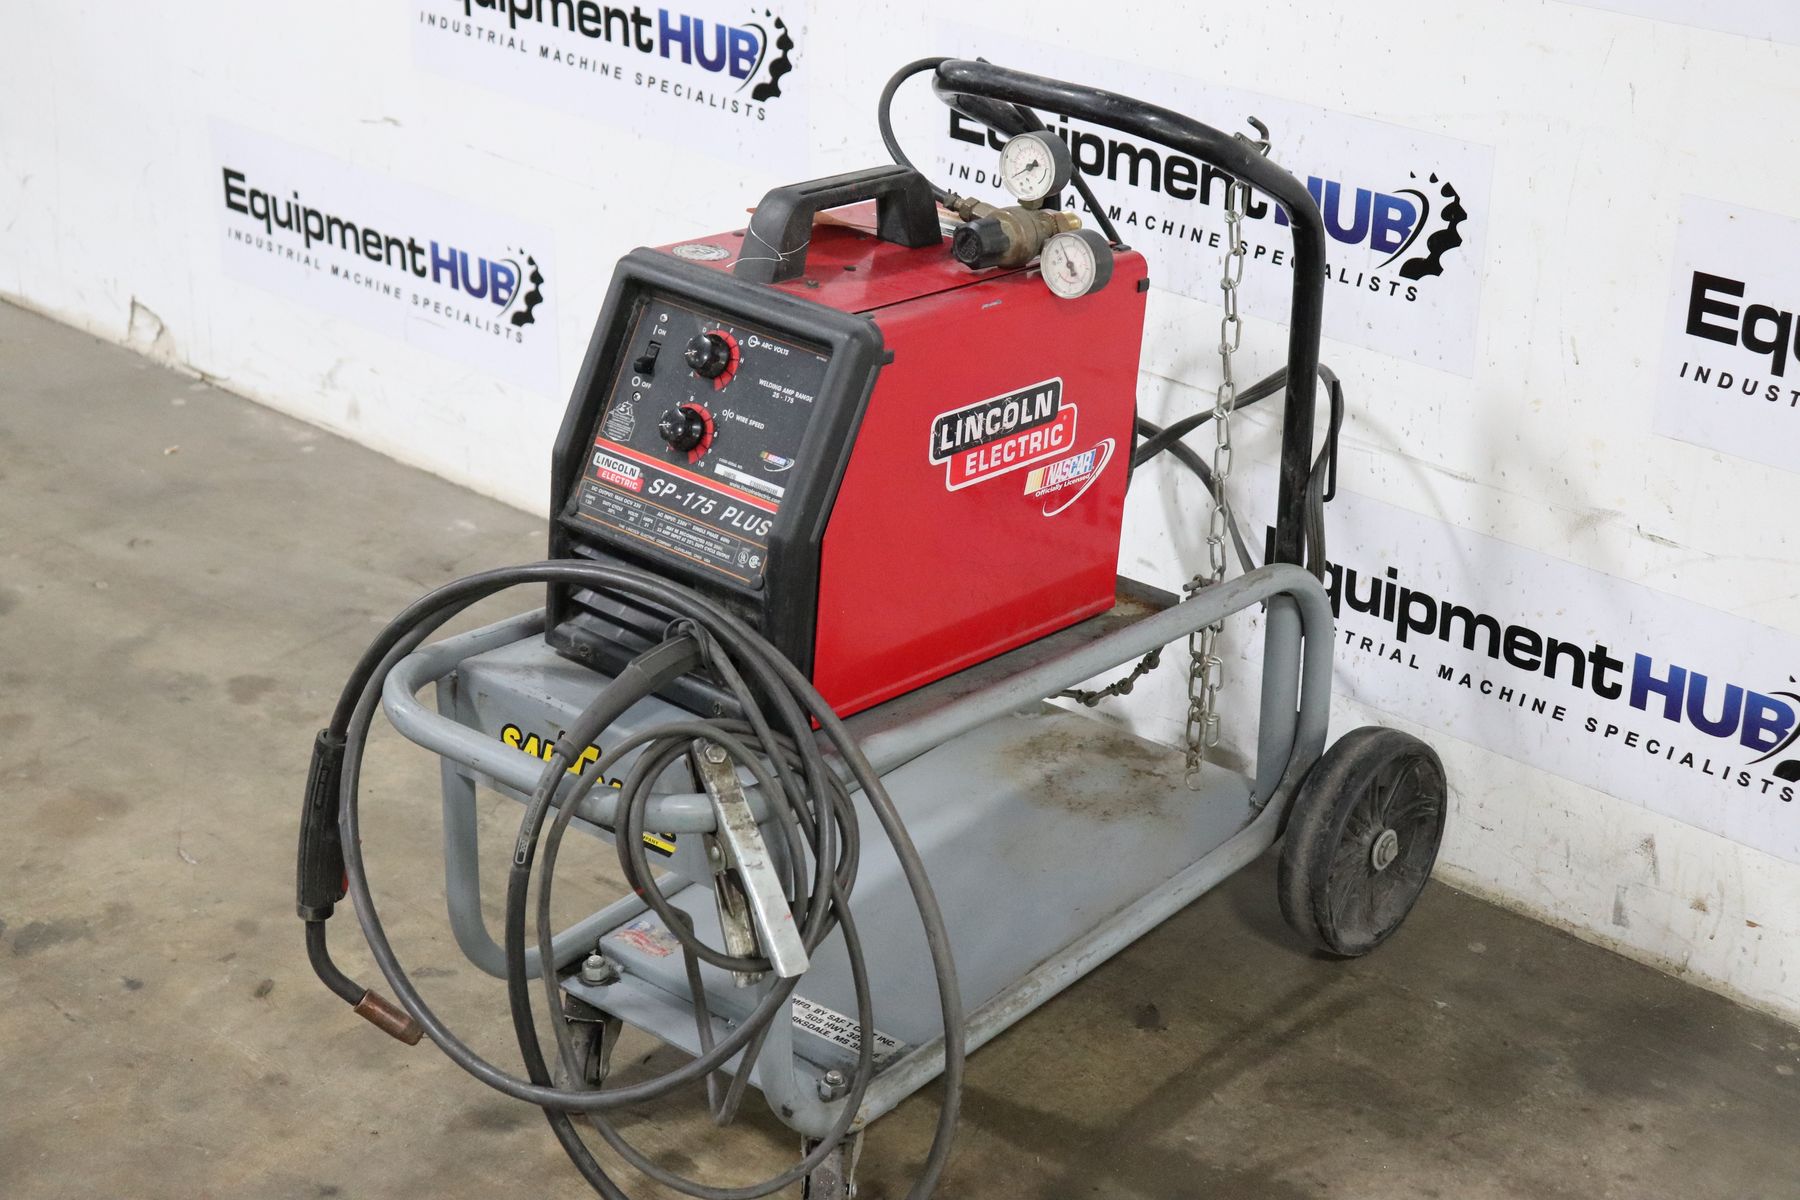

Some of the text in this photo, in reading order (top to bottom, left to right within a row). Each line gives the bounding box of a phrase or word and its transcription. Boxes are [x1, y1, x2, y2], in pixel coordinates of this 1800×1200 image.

[420, 11, 766, 121] INDUSTRIAL MACHINE SPECIALISTS
[222, 166, 515, 307] EquipmentHUB
[1108, 205, 1221, 249] MACHINE
[228, 228, 523, 344] INDUSTRIAL MACHINE SPECIALISTS
[1686, 270, 1800, 378] Eq
[761, 342, 790, 356] ARC VOLTS
[759, 378, 814, 403] WELDING AMP RANGE
[784, 396, 794, 404] 175
[736, 414, 764, 430] WIRE SPEED
[940, 390, 1053, 451] LINCOLN
[595, 454, 638, 479] LINCOLN
[965, 423, 1063, 476] ELECTRIC
[601, 470, 638, 490] ELECTRIC
[1046, 451, 1096, 486] NASCAR
[1036, 482, 1063, 497] Officially
[648, 478, 717, 514] SP-175
[719, 505, 773, 537] PLUS
[1264, 525, 1796, 754] quipmentHUB
[1437, 663, 1567, 722] MACHINE
[1584, 716, 1795, 803] SPECIALISTS
[824, 1022, 848, 1034] HWY
[827, 1014, 846, 1024] SAF
[877, 1036, 896, 1048] INC.
[833, 1035, 850, 1045] MS
